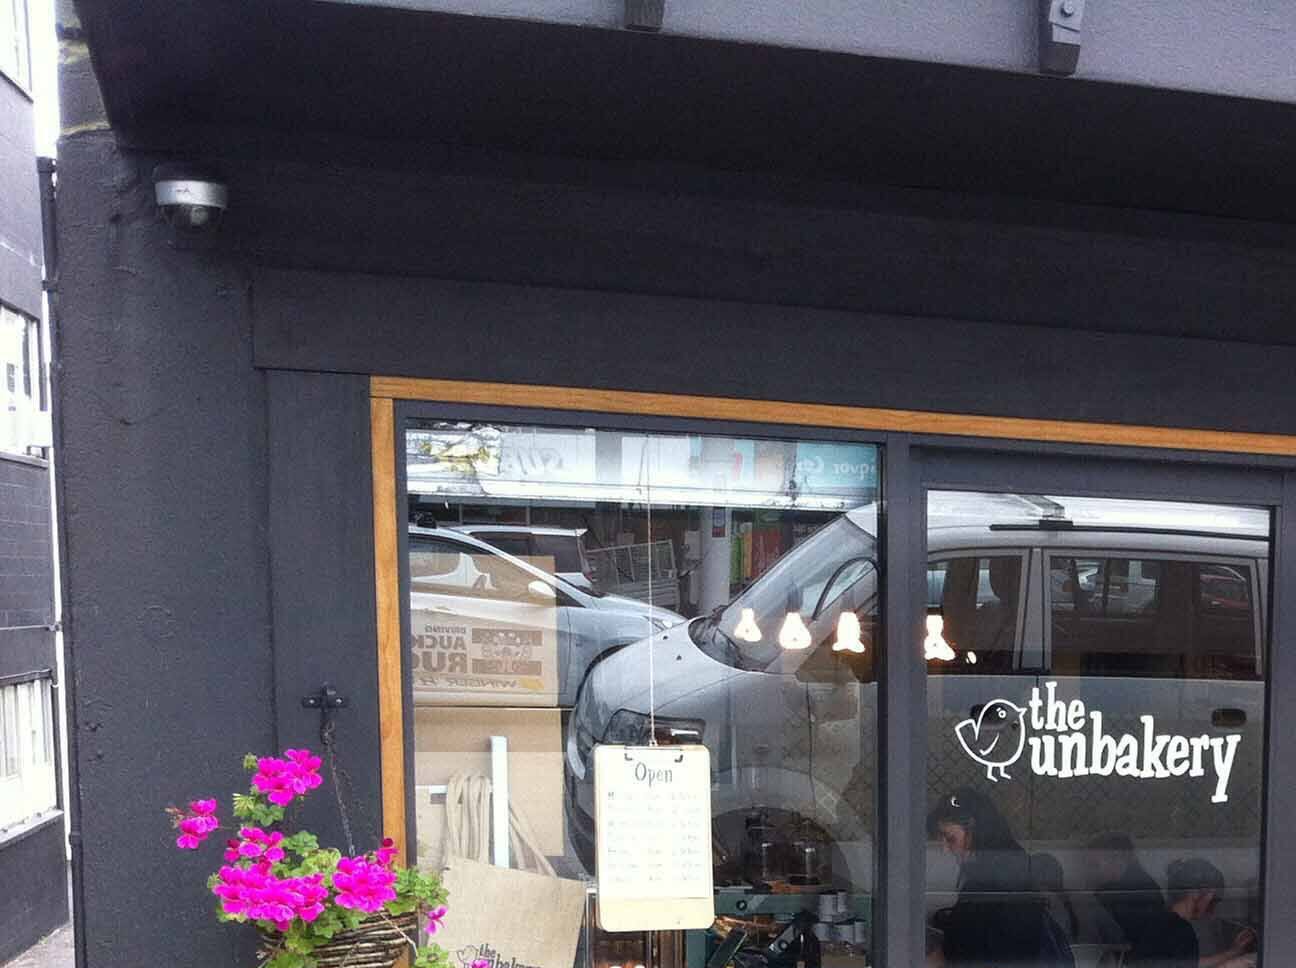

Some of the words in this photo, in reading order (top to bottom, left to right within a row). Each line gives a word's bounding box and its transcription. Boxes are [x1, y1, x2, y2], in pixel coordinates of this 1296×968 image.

[1028, 681, 1086, 732] the
[634, 762, 673, 788] Open
[1028, 711, 1241, 803] unbakery
[479, 942, 497, 958] the
